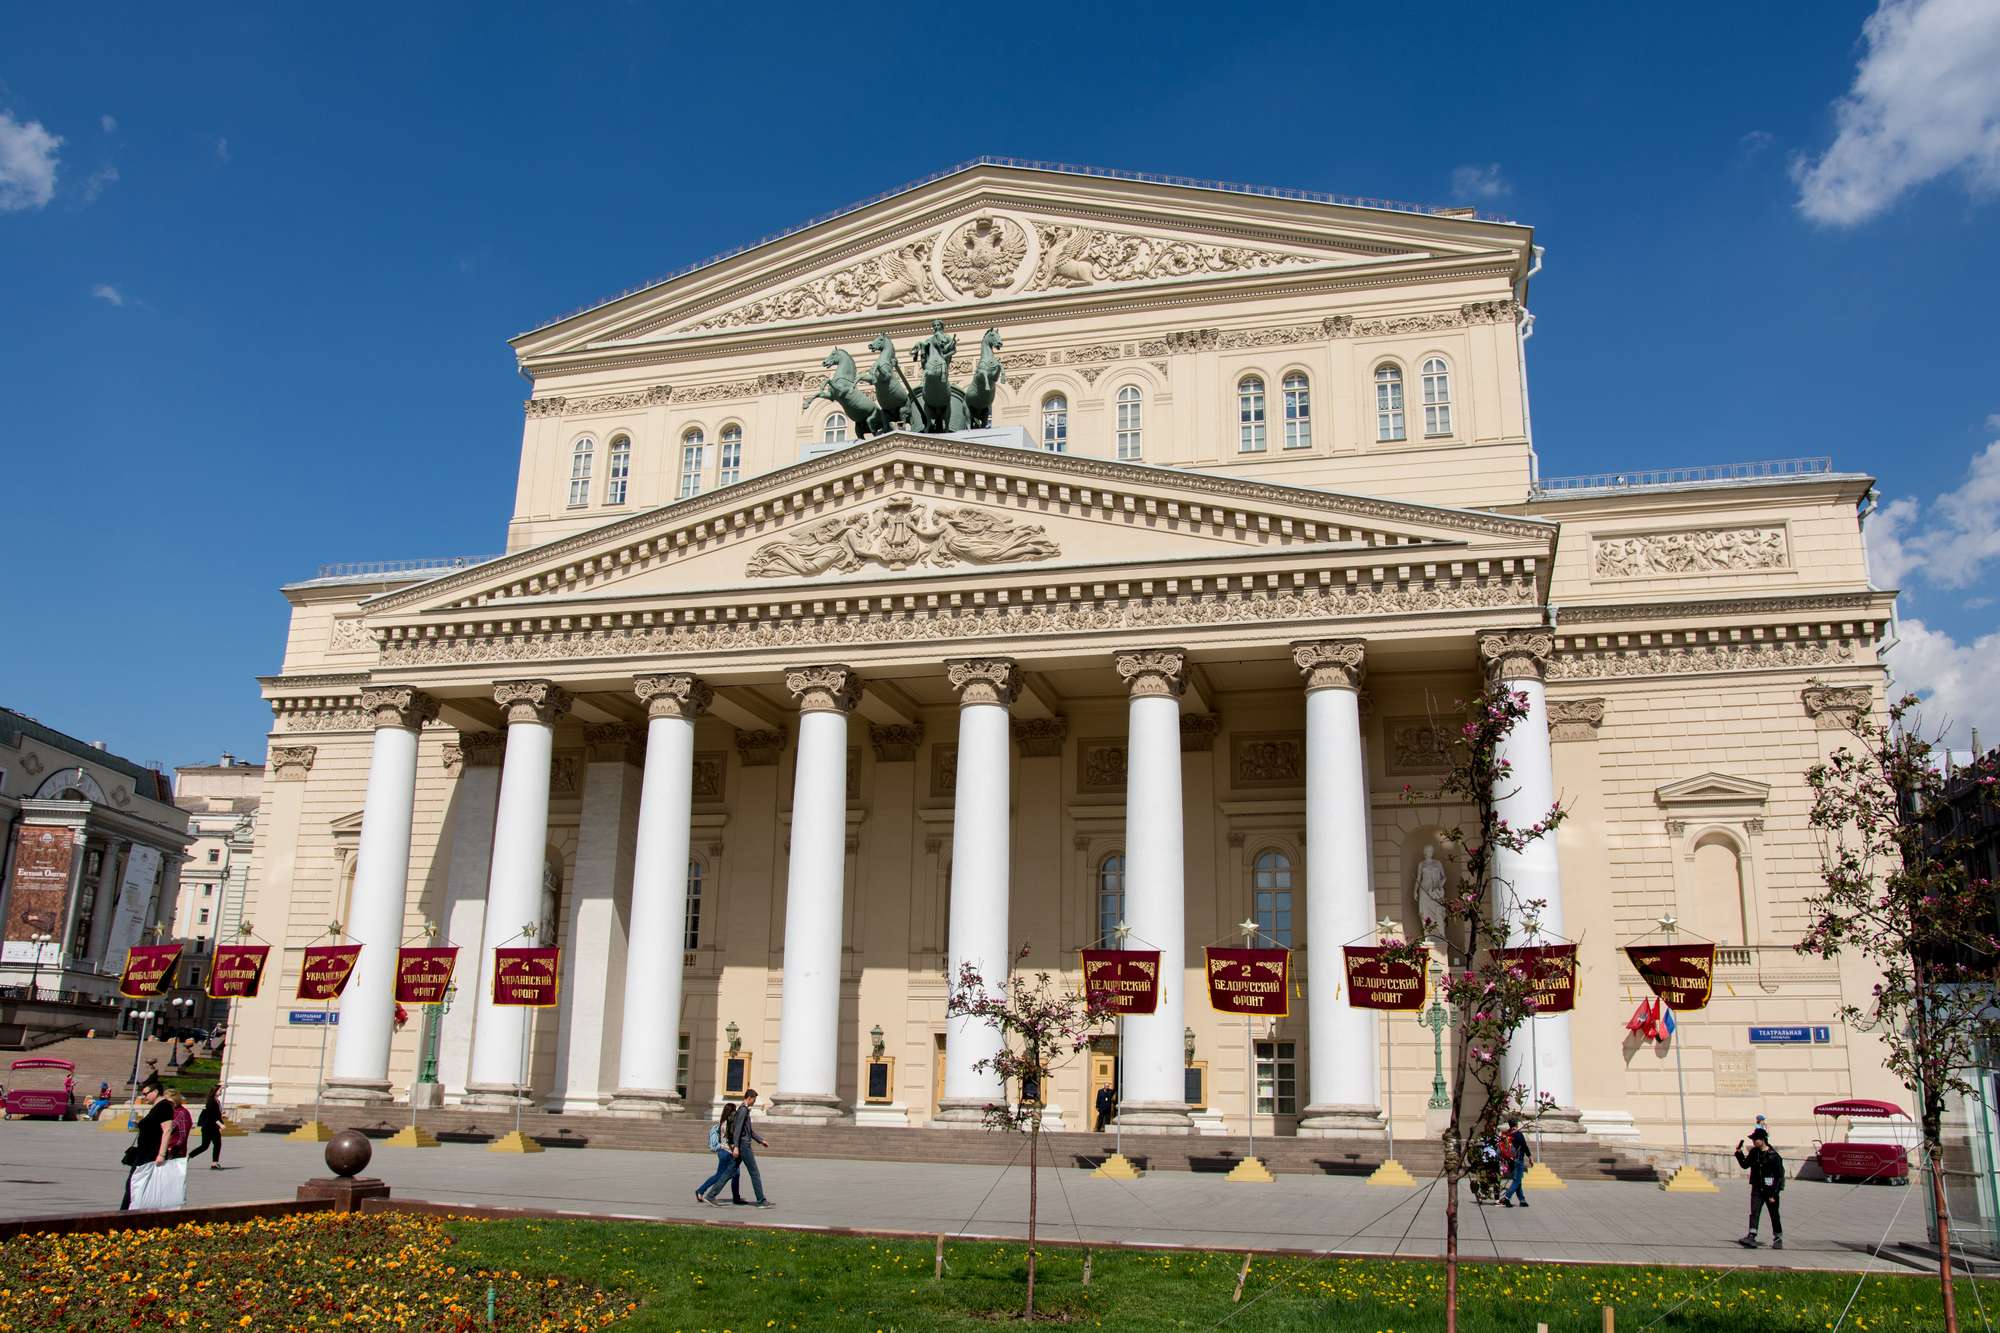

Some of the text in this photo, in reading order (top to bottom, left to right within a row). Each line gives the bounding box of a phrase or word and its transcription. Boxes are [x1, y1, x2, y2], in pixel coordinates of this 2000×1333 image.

[327, 959, 335, 969] 2
[422, 960, 429, 971] 3
[521, 961, 529, 972] 4
[1379, 962, 1388, 974] 3
[1241, 965, 1252, 977] 2
[501, 975, 552, 986] УКРАИНСКИЙ
[1090, 979, 1152, 992] БЕЛОРУССКИЙ
[1214, 979, 1280, 993] БЕЛОРУССКИЙ
[1352, 976, 1419, 990] БЕЛОРУССКИЙ
[413, 987, 436, 997] ФРОНТ
[511, 988, 540, 1000] ФРОНТ
[1370, 992, 1403, 1004] ФРОНТ
[1232, 994, 1265, 1007] ФРОНТ
[331, 1013, 337, 1022] 1
[1820, 1029, 1825, 1039] 1
